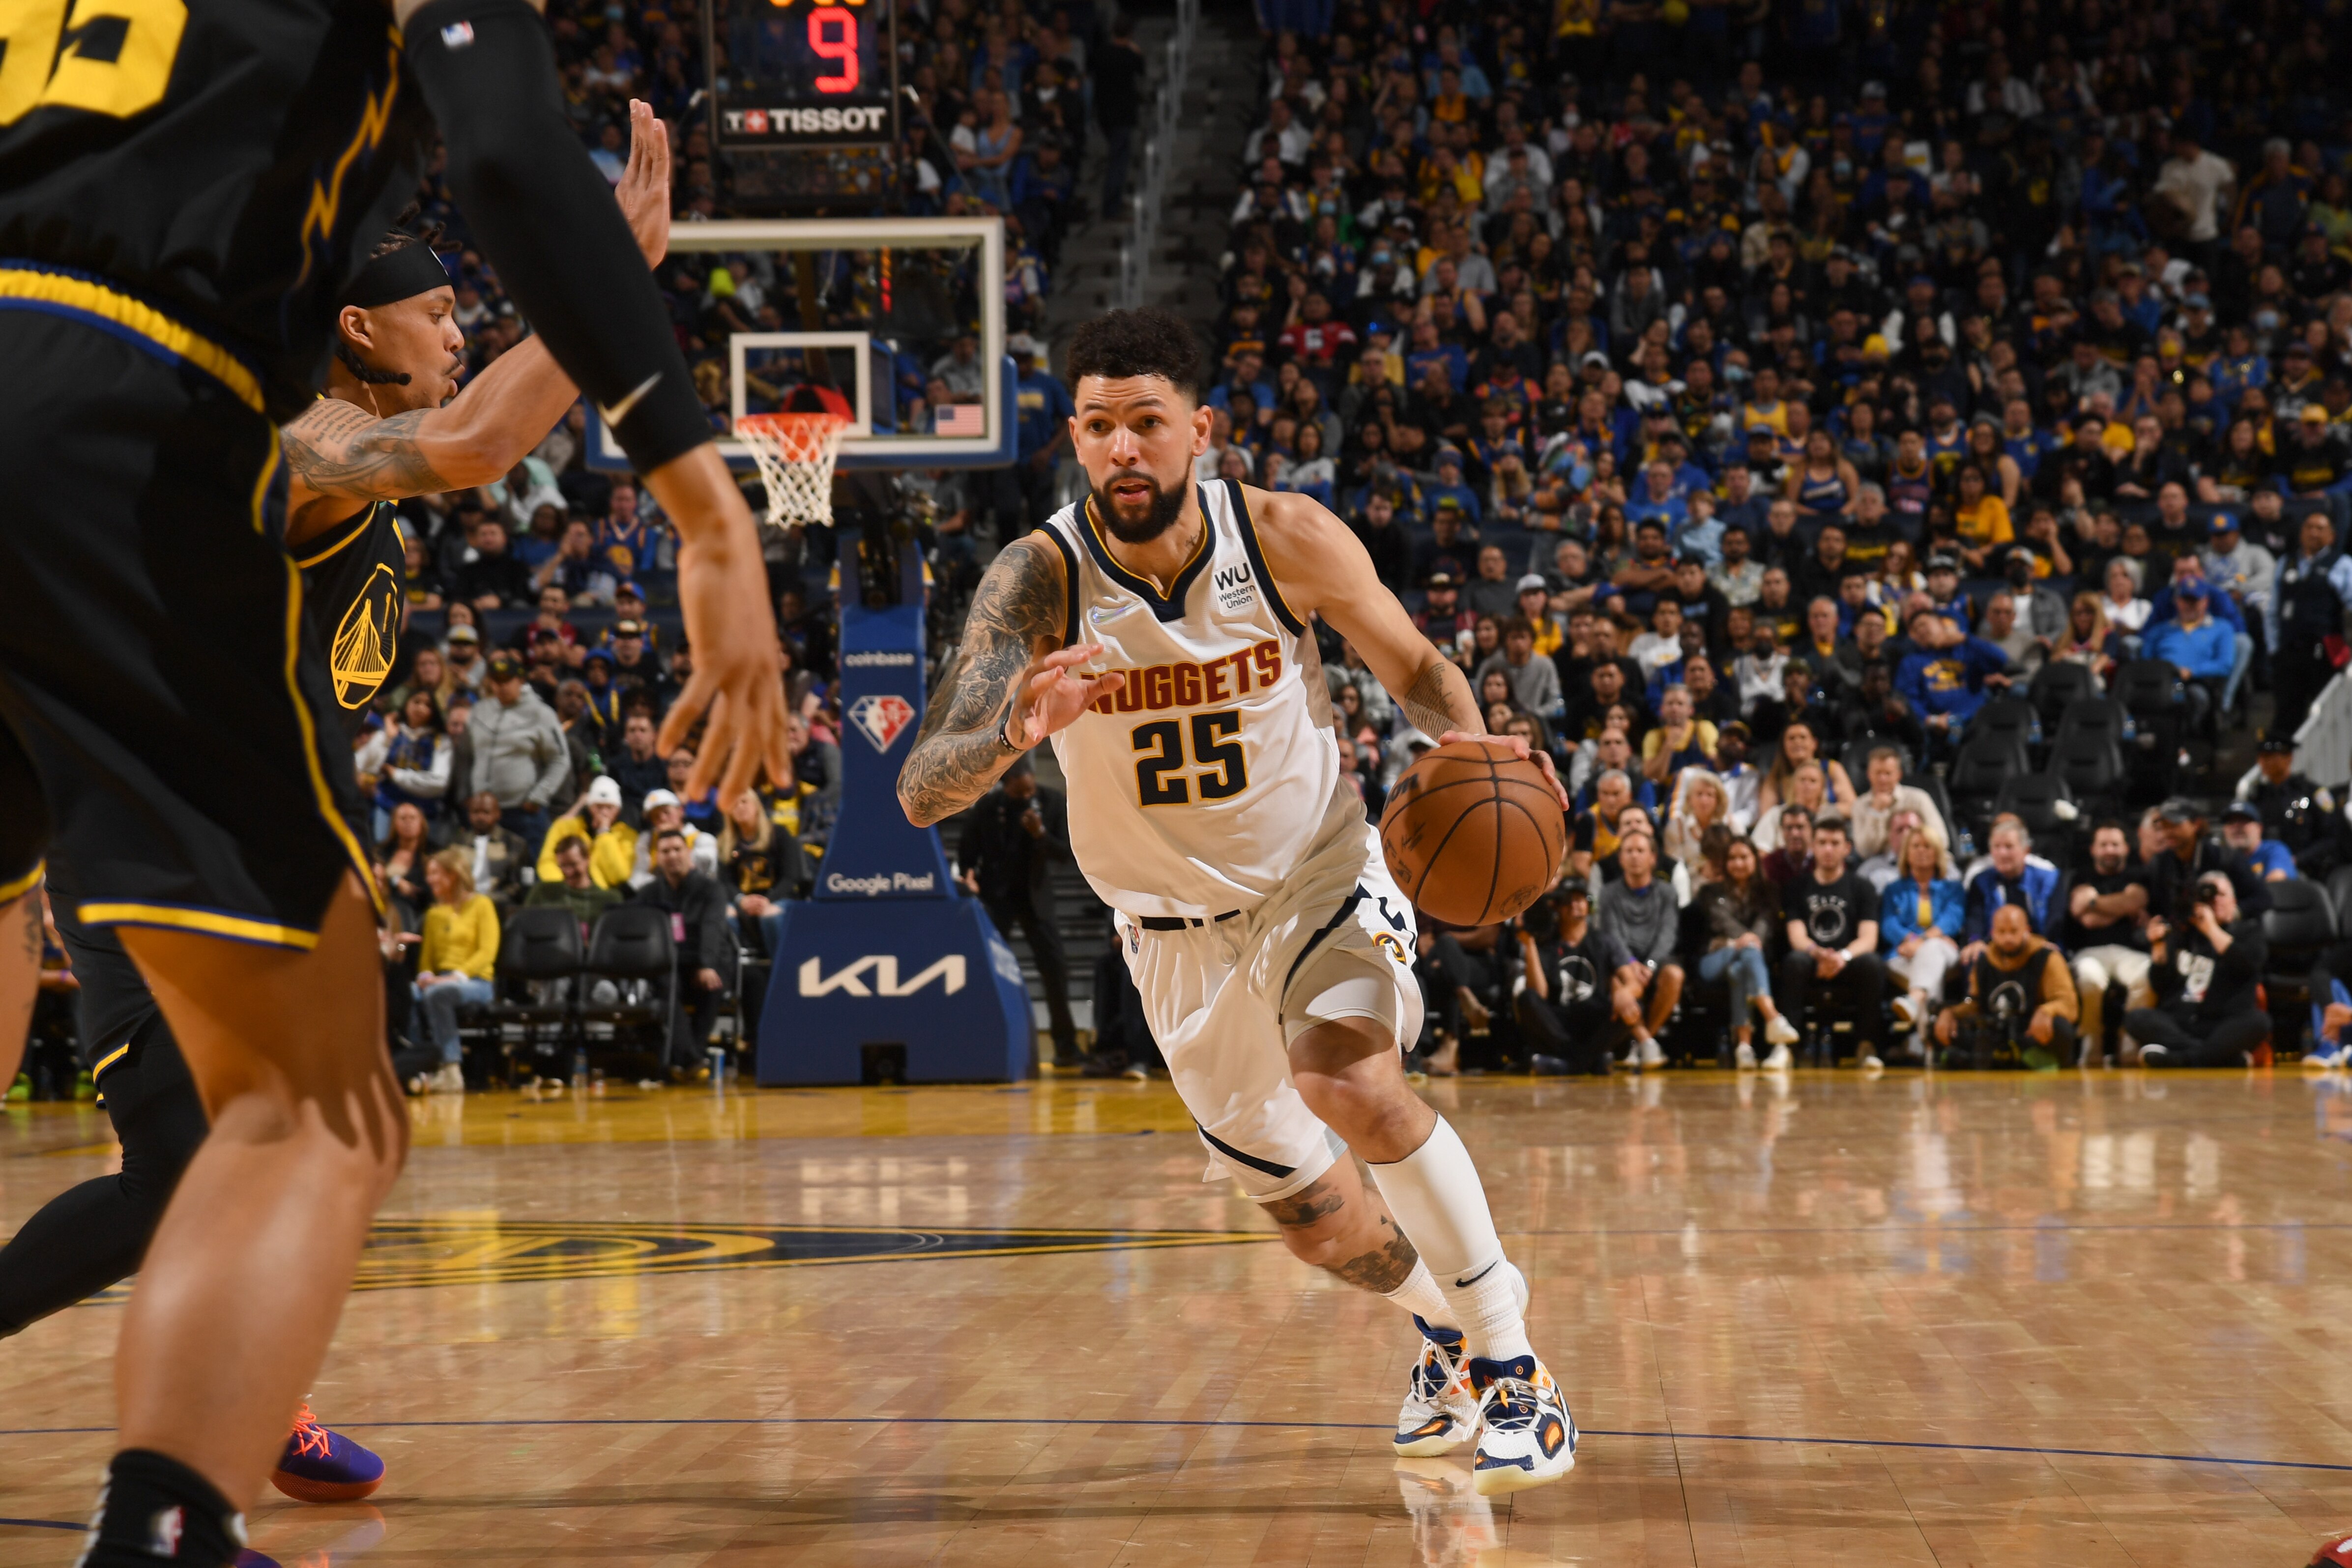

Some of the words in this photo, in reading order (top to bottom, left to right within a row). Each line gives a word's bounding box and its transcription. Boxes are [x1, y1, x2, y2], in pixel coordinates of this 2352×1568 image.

[808, 7, 859, 93] 9
[768, 108, 886, 132] TISSOT
[1214, 562, 1250, 591] WU
[1219, 584, 1255, 602] Western
[1226, 595, 1252, 609] Union
[845, 651, 915, 667] coinbase
[1130, 709, 1249, 809] 25
[827, 872, 891, 897] Google
[893, 871, 934, 891] Pixel
[798, 954, 966, 997] KIA
